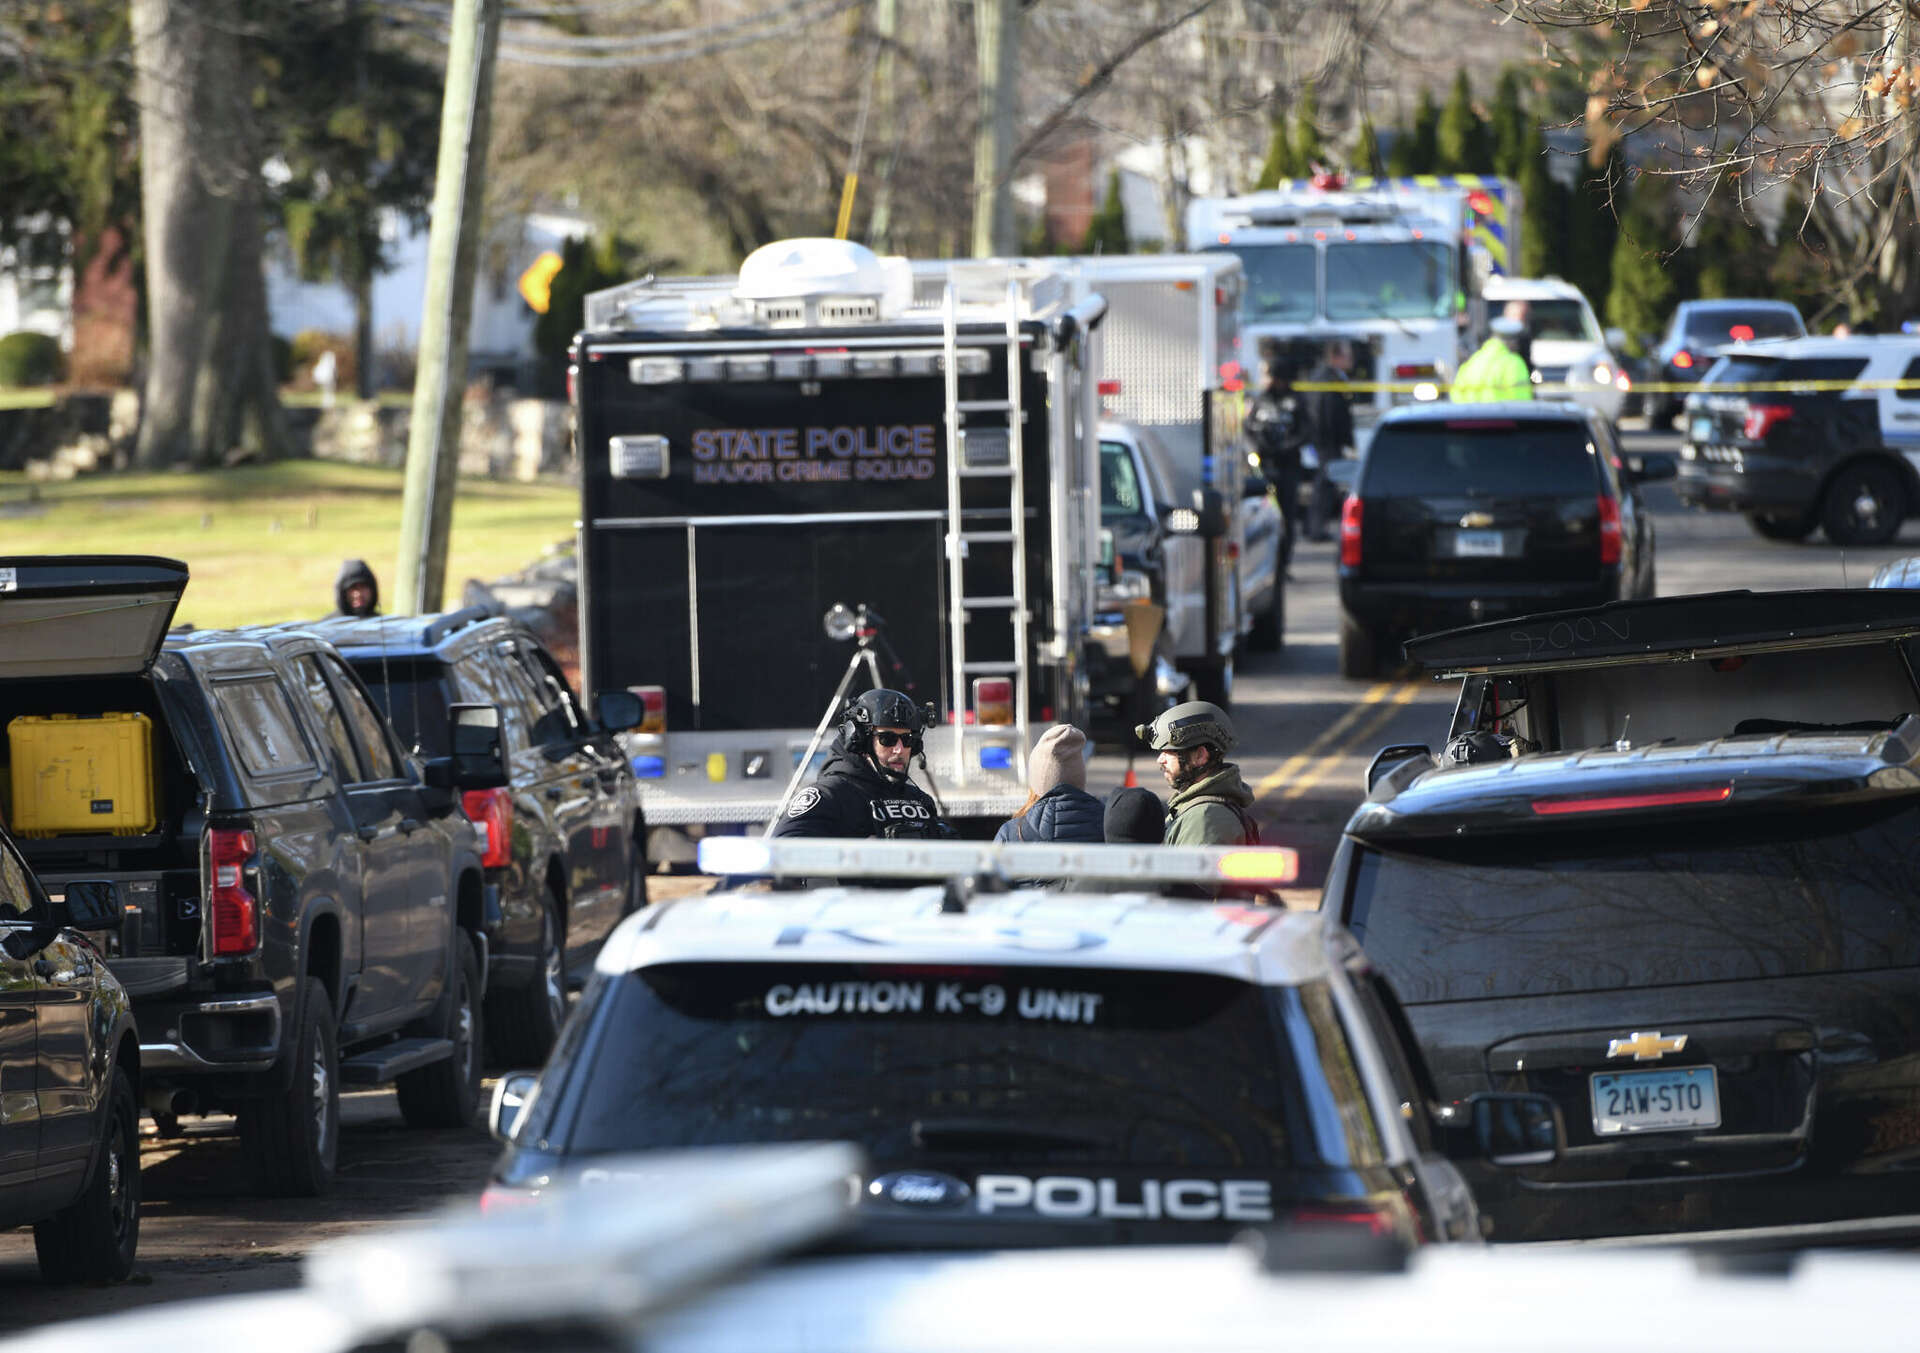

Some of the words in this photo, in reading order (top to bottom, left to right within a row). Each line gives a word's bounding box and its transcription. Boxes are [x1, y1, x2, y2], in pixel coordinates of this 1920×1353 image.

[692, 428, 798, 460] STATE
[806, 425, 936, 457] POLICE
[694, 461, 774, 483] MAJOR
[778, 460, 850, 481] CRIME
[855, 459, 935, 480] SQUAD
[885, 805, 930, 819] EOD
[765, 982, 923, 1016] CAUTION
[935, 982, 1005, 1016] K-9
[1018, 988, 1102, 1023] UNIT
[976, 1174, 1272, 1220] POLICE
